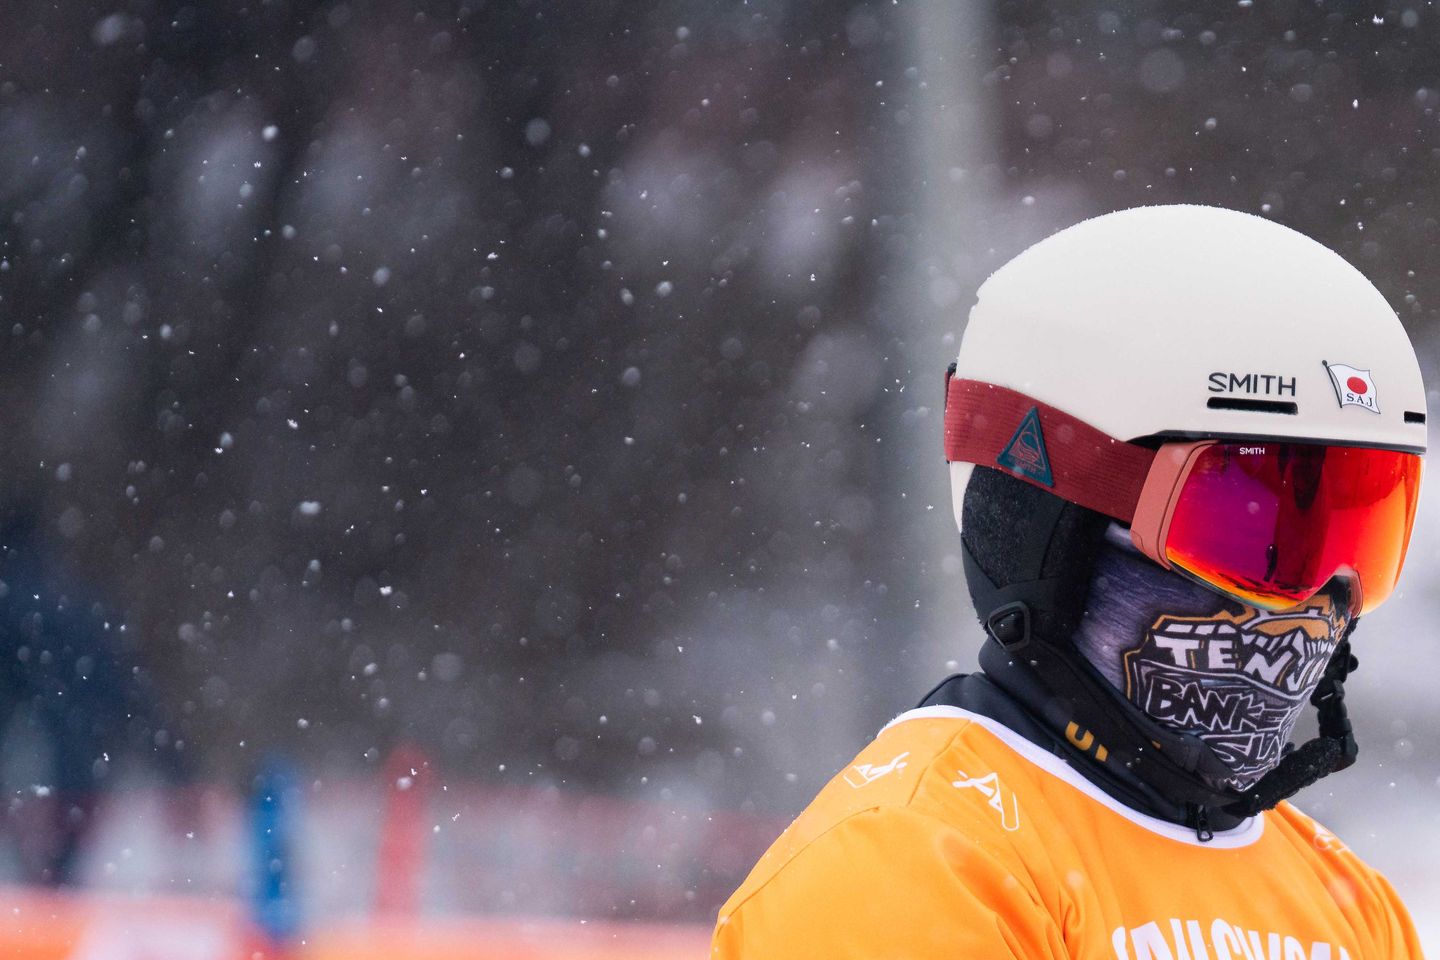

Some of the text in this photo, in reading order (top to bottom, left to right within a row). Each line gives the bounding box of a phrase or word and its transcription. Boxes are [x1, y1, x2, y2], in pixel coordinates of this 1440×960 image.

[1208, 372, 1296, 397] SMITH
[1239, 446, 1266, 456] SMITH
[1146, 675, 1298, 733] BANKE
